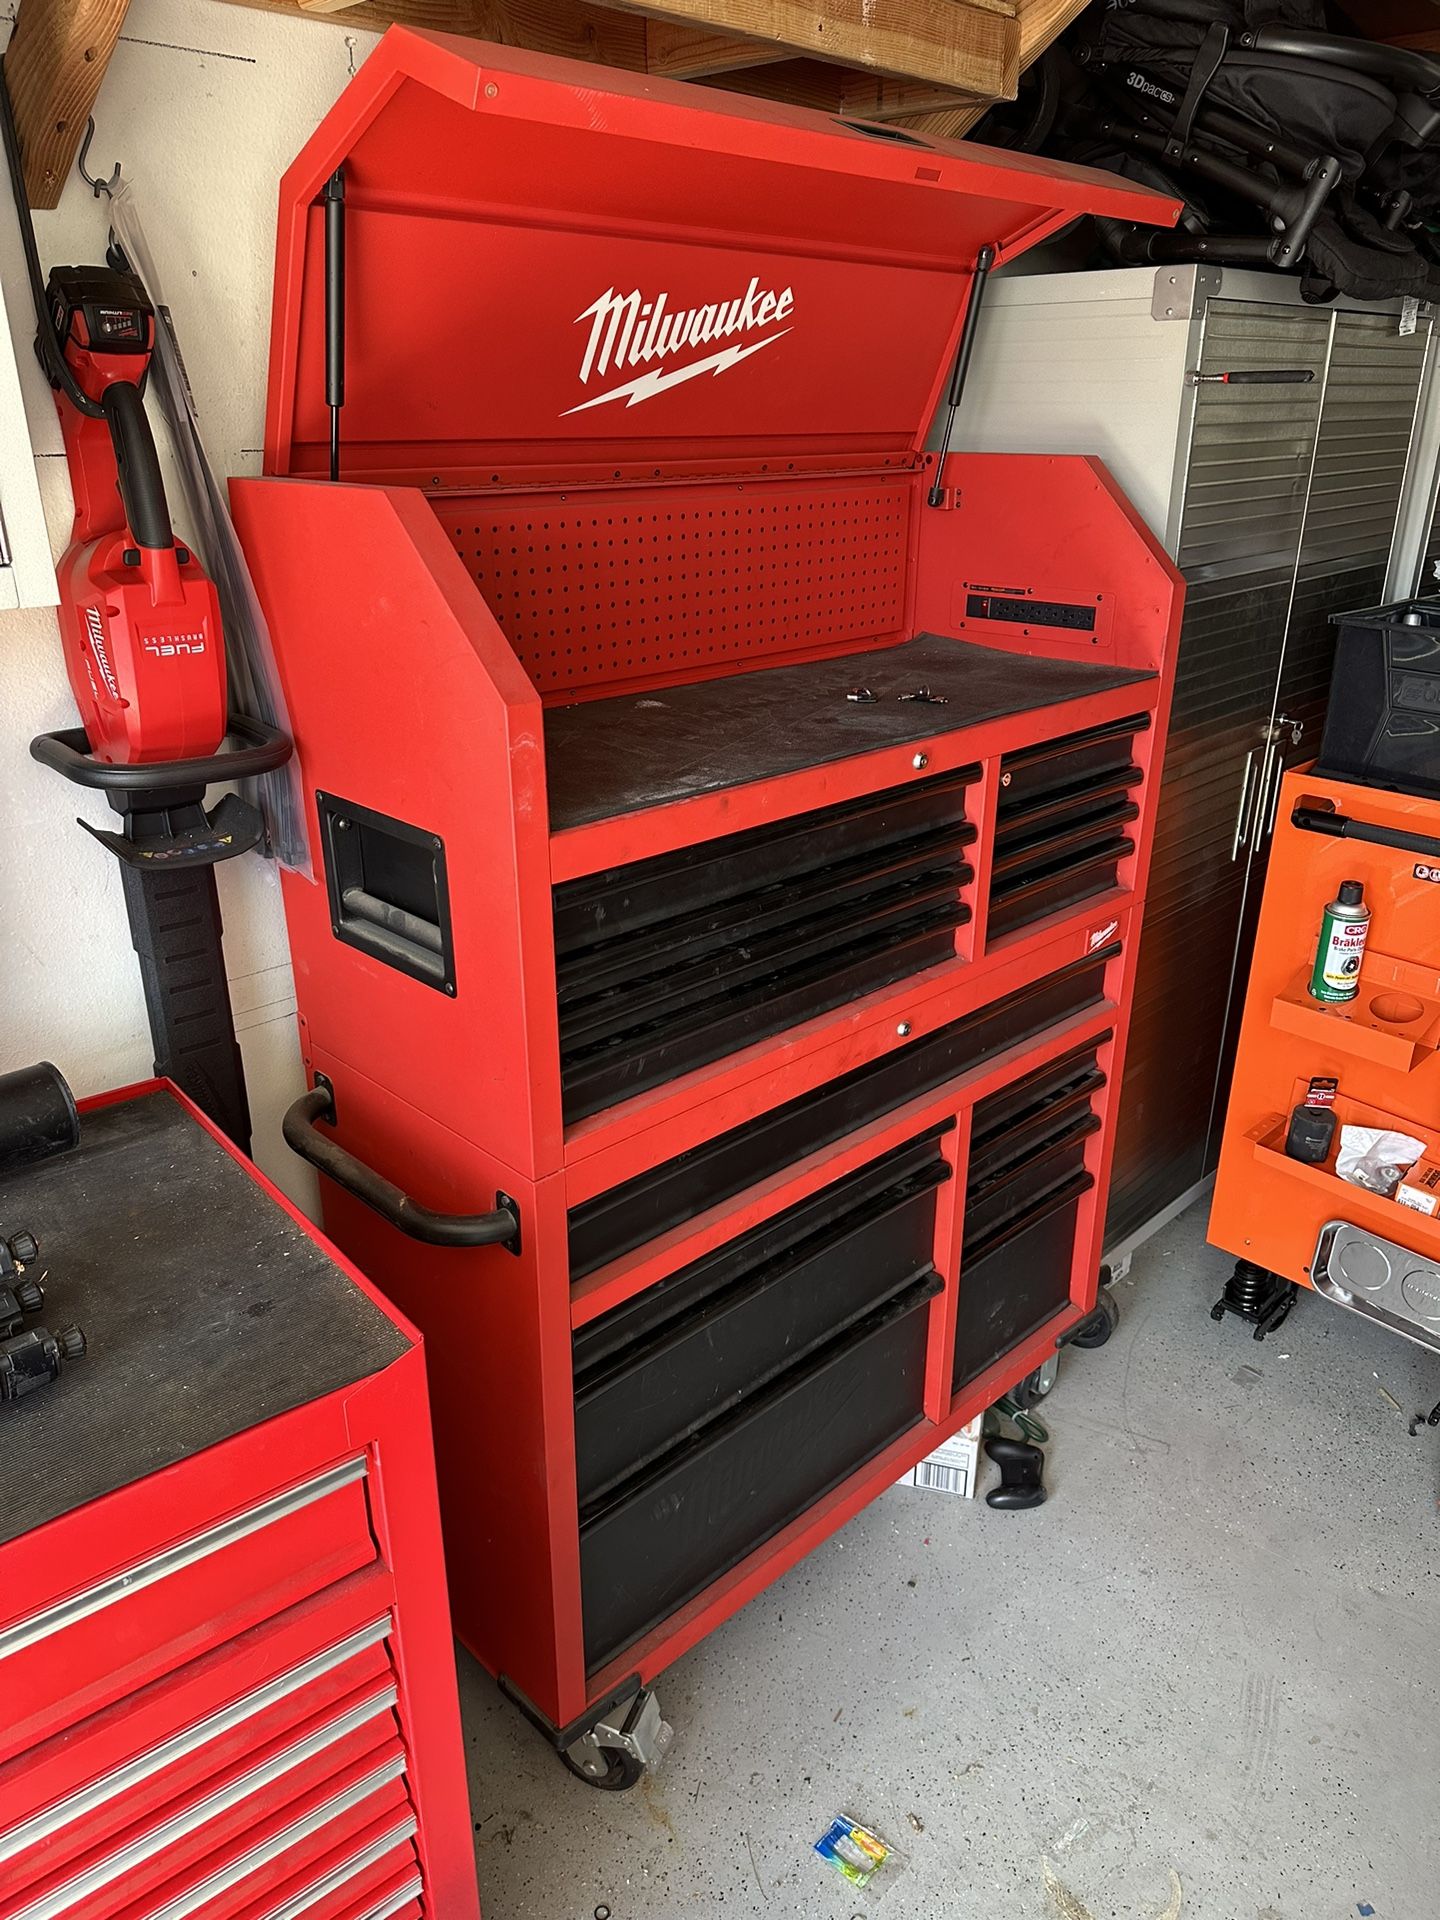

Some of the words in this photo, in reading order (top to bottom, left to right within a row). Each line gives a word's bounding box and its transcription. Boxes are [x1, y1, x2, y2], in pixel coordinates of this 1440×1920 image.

[573, 277, 794, 385] Milwaukee
[85, 605, 119, 700] Milwaukee
[143, 634, 204, 644] BRUSHLESS
[145, 642, 205, 657] FUEL
